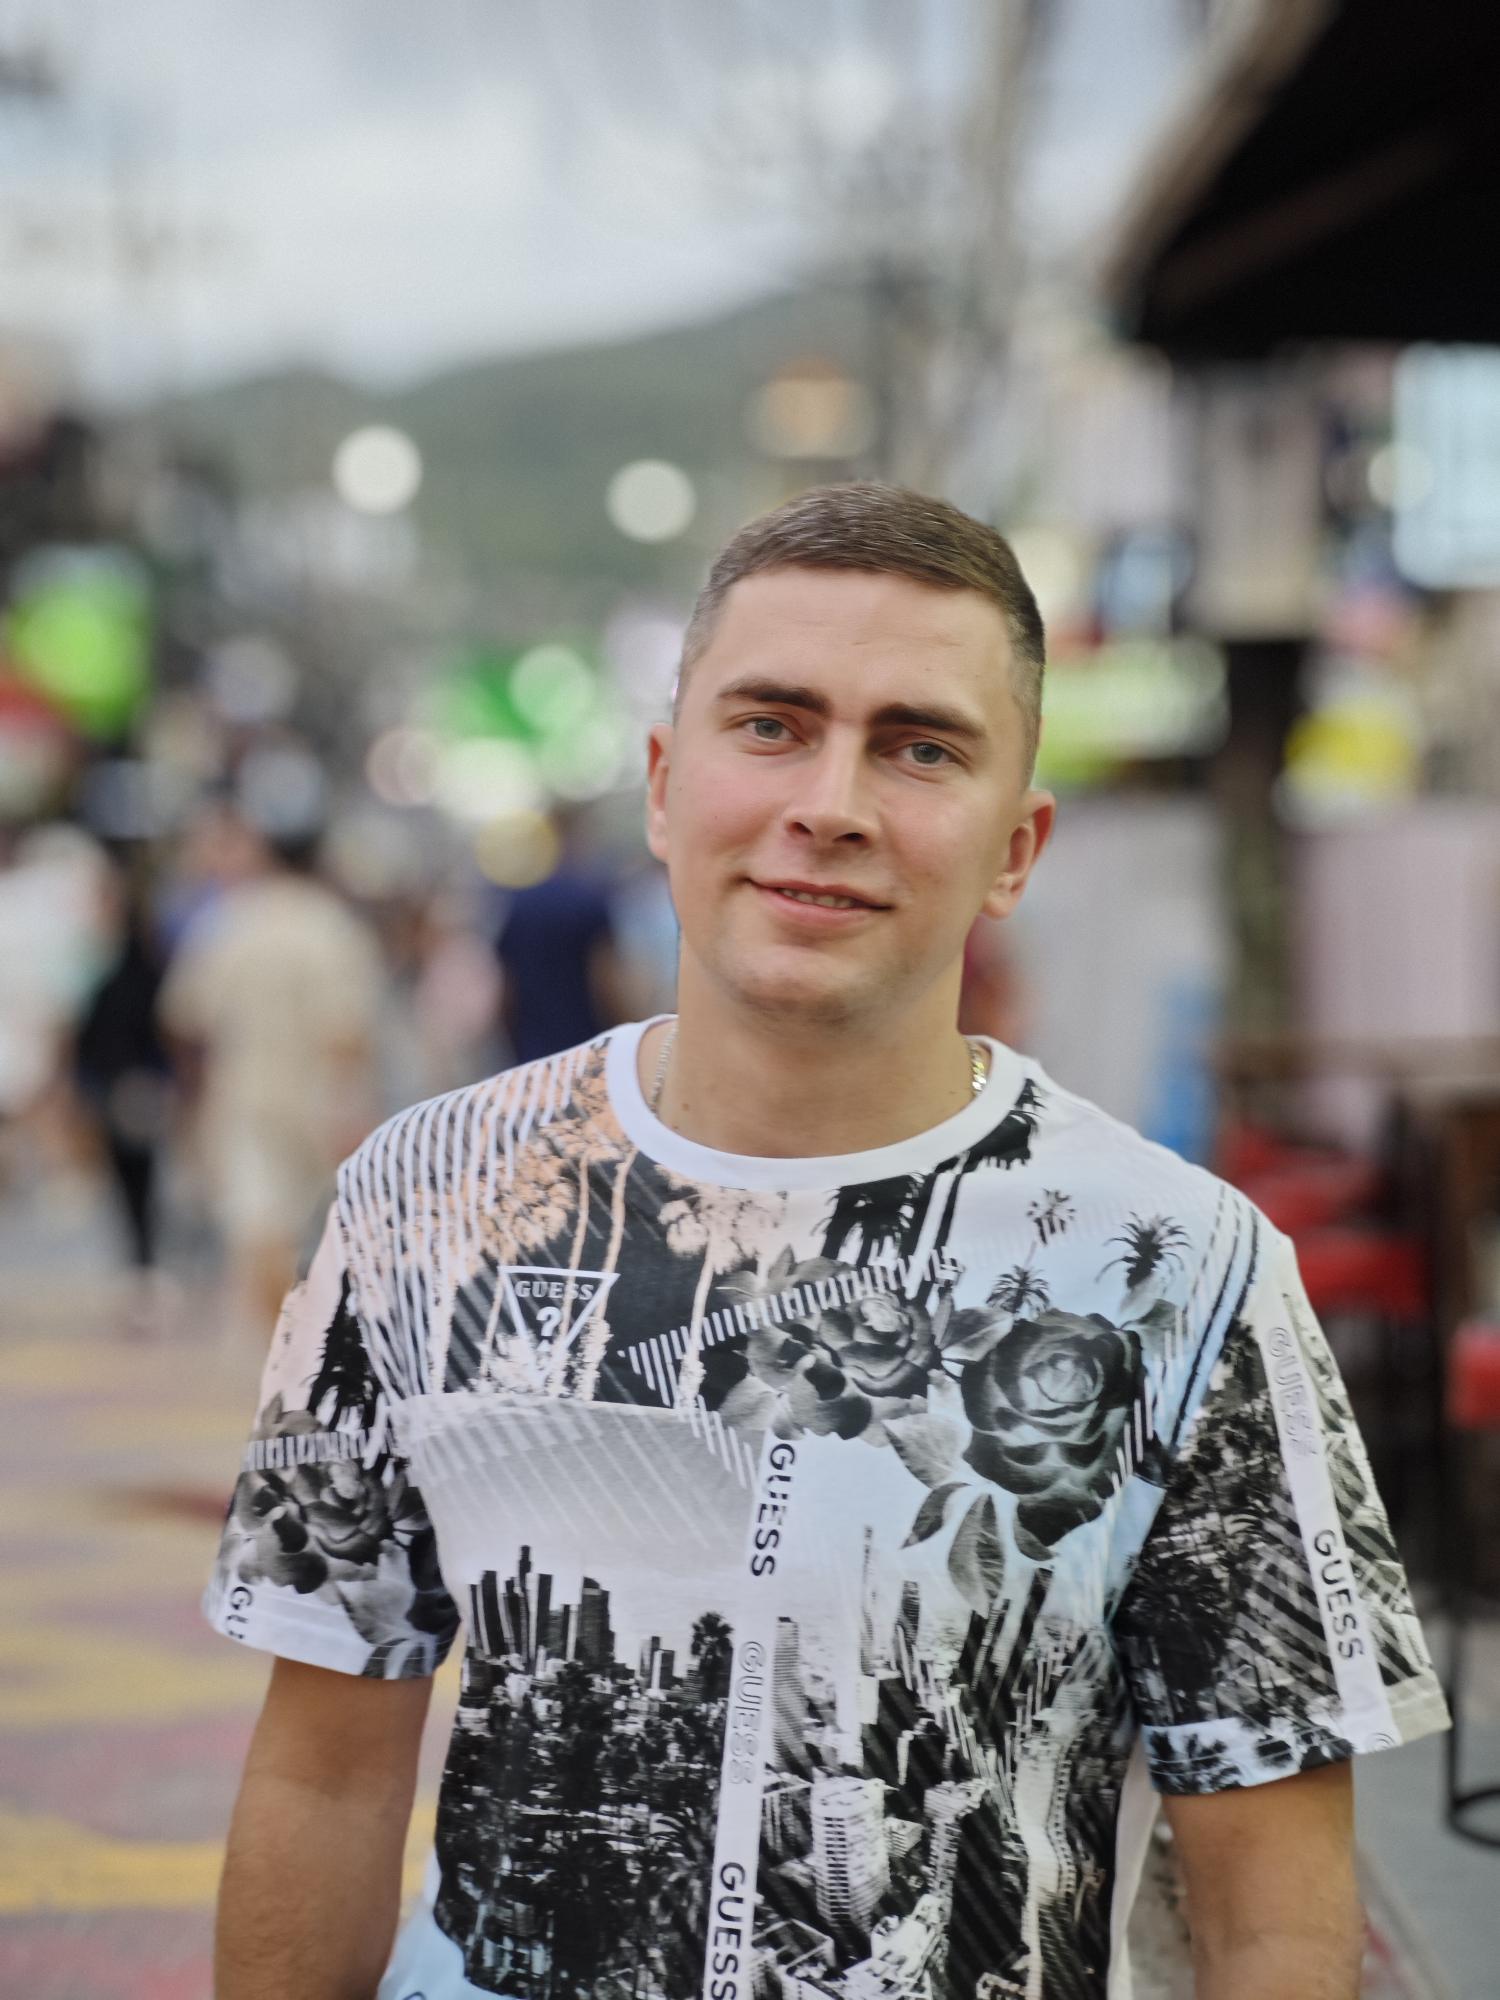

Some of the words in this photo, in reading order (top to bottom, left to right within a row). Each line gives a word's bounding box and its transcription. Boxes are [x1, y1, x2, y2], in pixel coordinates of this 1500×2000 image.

[514, 1280, 595, 1300] GUESS
[751, 1443, 796, 1577] GUESS
[1314, 1529, 1363, 1658] GUESS
[728, 1640, 768, 1785] GUESS
[710, 1862, 746, 2000] GUESS
